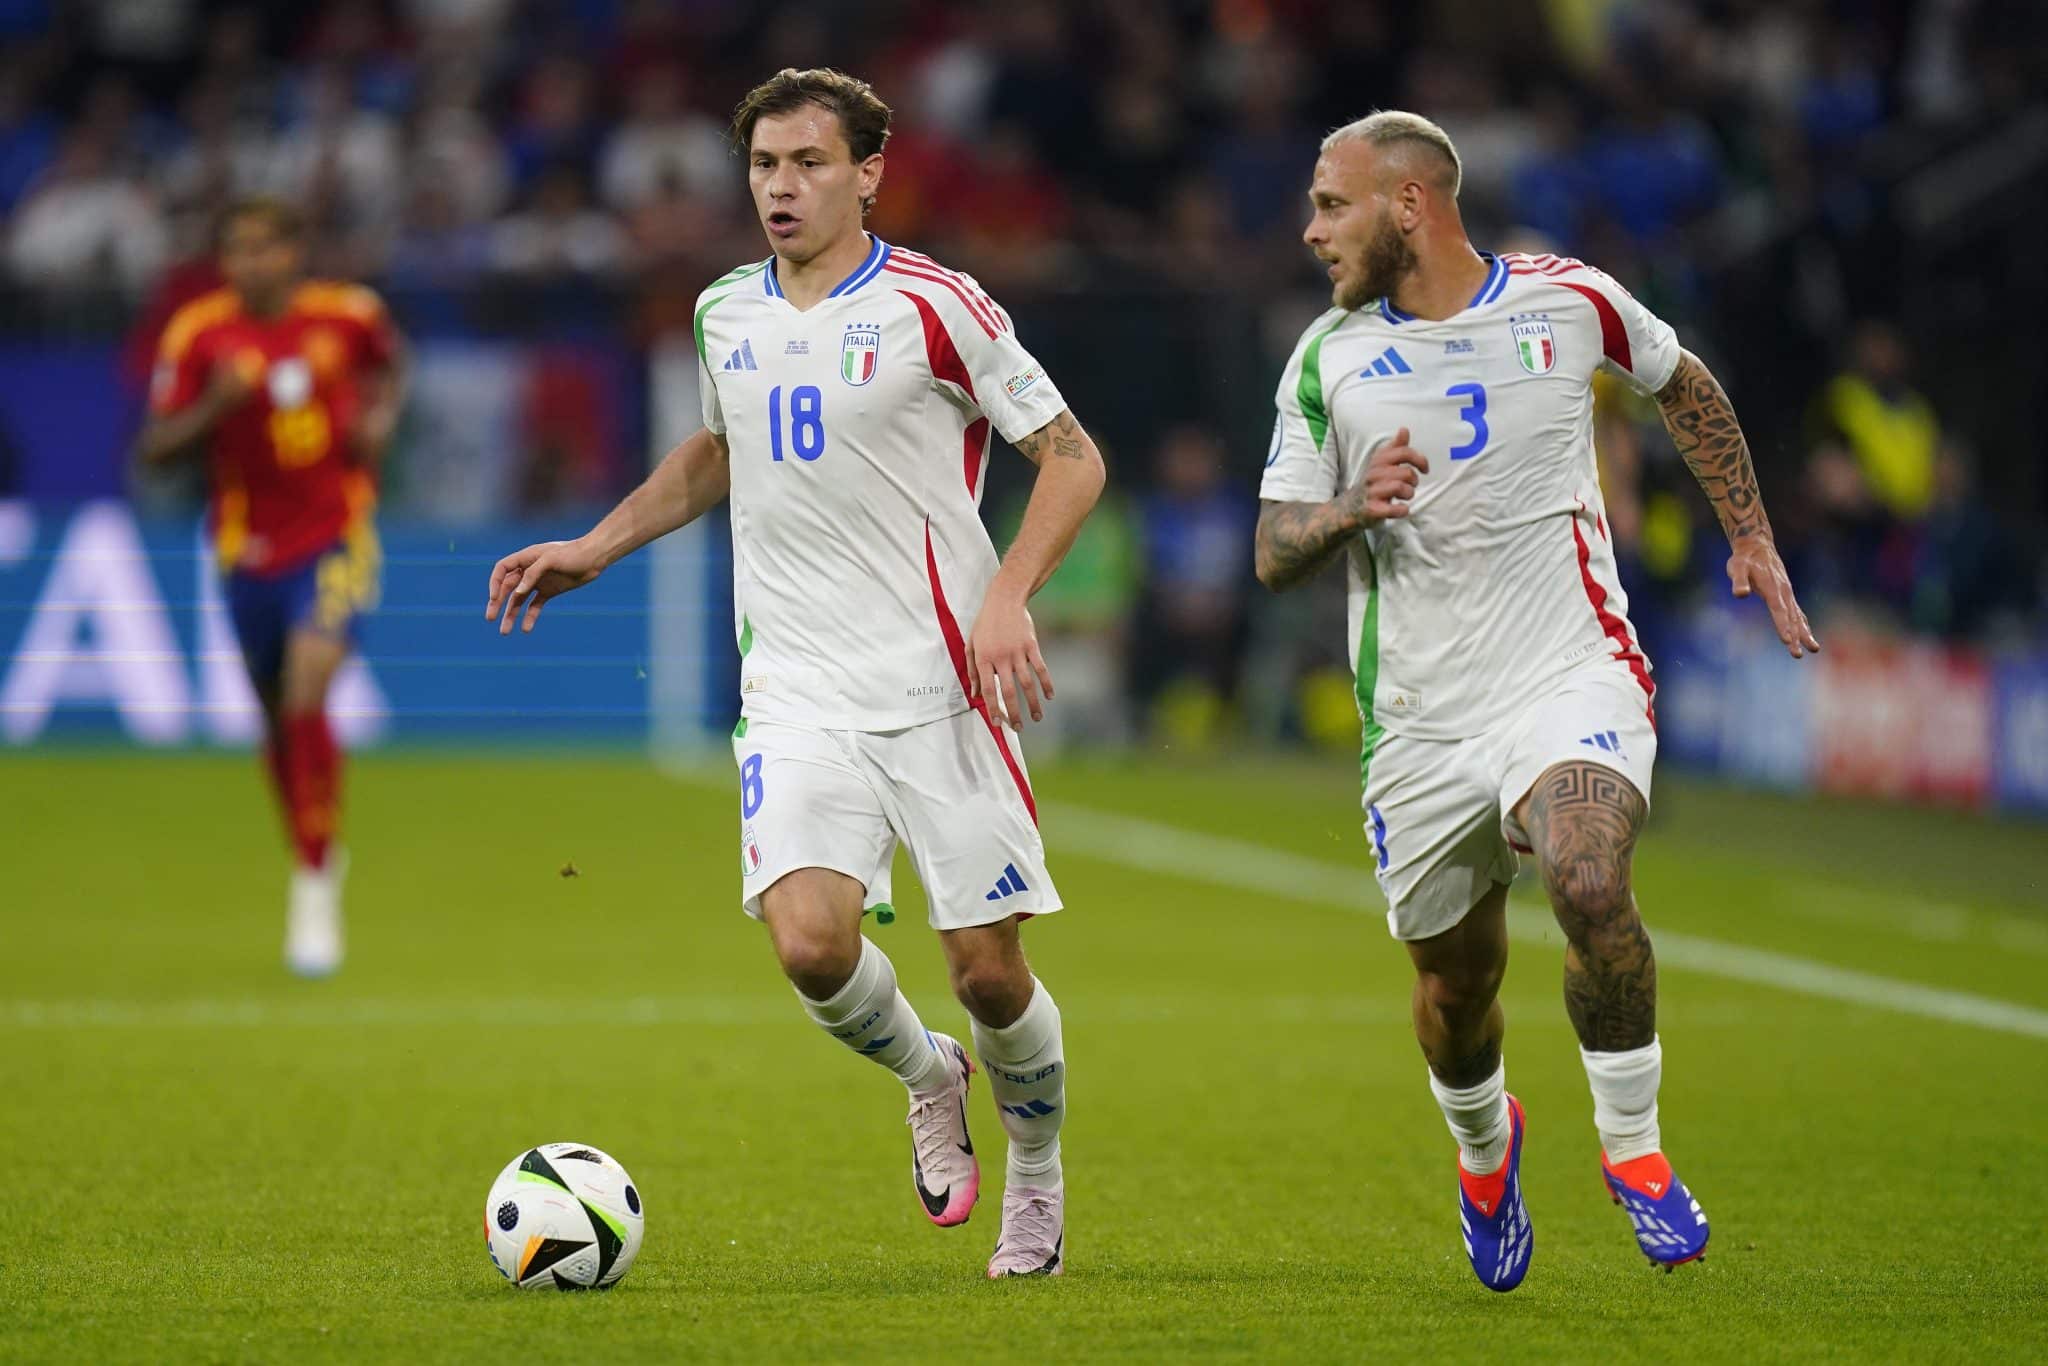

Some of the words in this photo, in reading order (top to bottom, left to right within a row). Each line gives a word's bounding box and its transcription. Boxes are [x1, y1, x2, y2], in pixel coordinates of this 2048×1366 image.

[846, 335, 876, 347] ITALIA
[1515, 324, 1549, 336] ITALIA
[769, 384, 825, 461] 18
[1446, 383, 1489, 460] 3
[985, 1059, 1056, 1084] ITALIA
